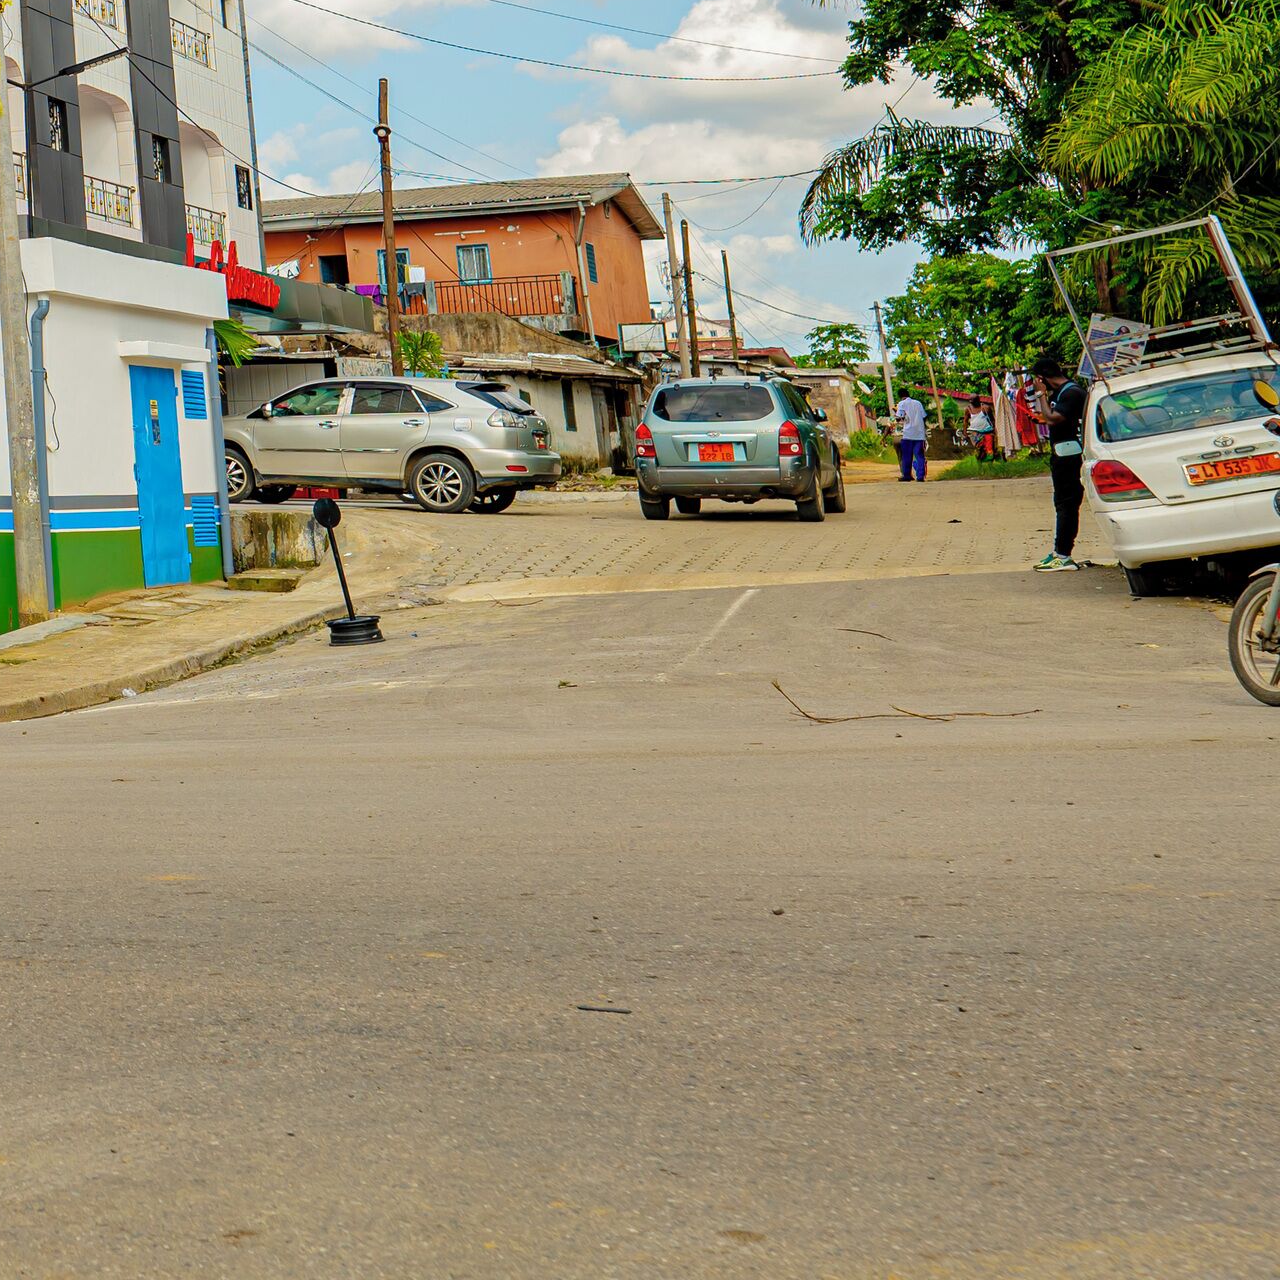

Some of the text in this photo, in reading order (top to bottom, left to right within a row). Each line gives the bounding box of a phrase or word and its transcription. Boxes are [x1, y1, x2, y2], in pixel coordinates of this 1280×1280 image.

[712, 444, 723, 453] LT
[1201, 456, 1273, 478] LT 535 JK
